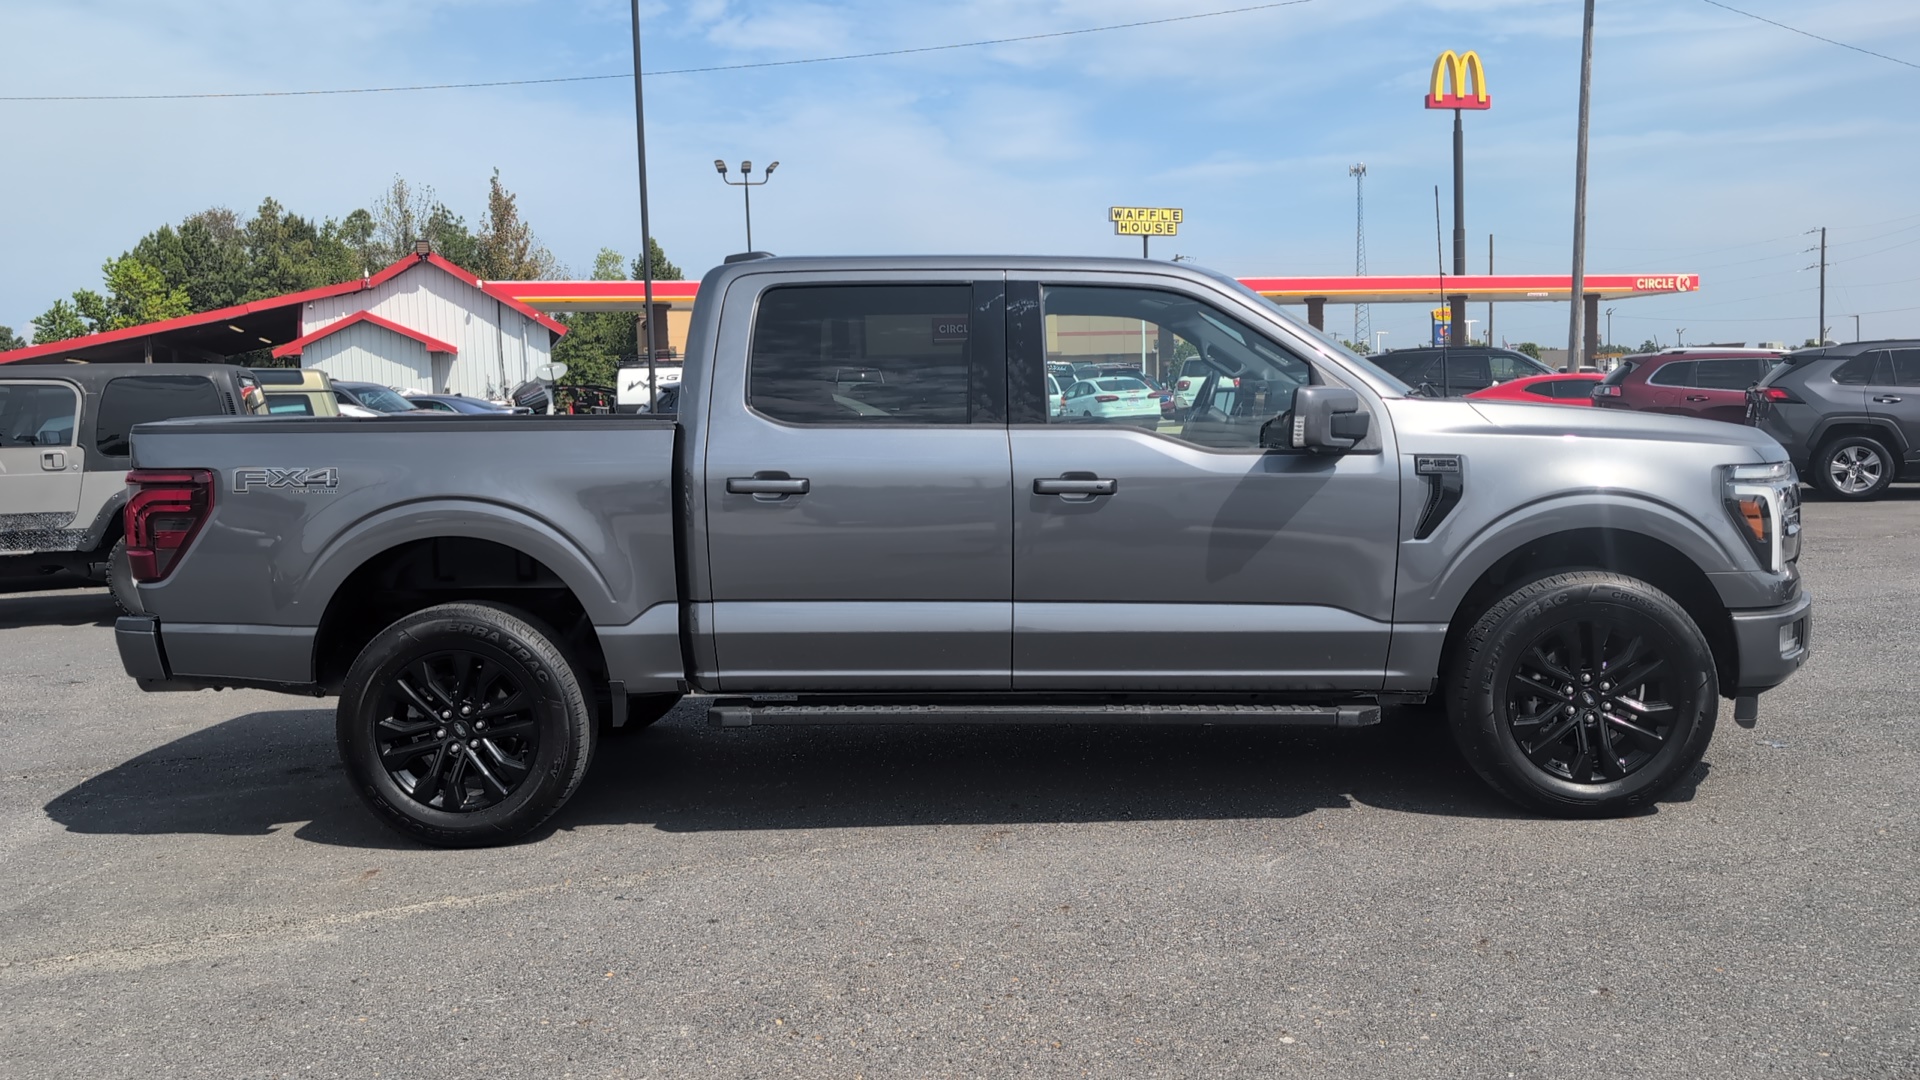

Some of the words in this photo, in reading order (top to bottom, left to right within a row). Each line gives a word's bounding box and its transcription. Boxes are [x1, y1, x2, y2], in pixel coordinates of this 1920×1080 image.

[1113, 209, 1180, 220] WAFFLE
[1120, 222, 1174, 233] HOUSE
[1636, 278, 1674, 289] CIRCLE
[233, 467, 339, 494] FX4
[506, 638, 549, 684] TRAC
